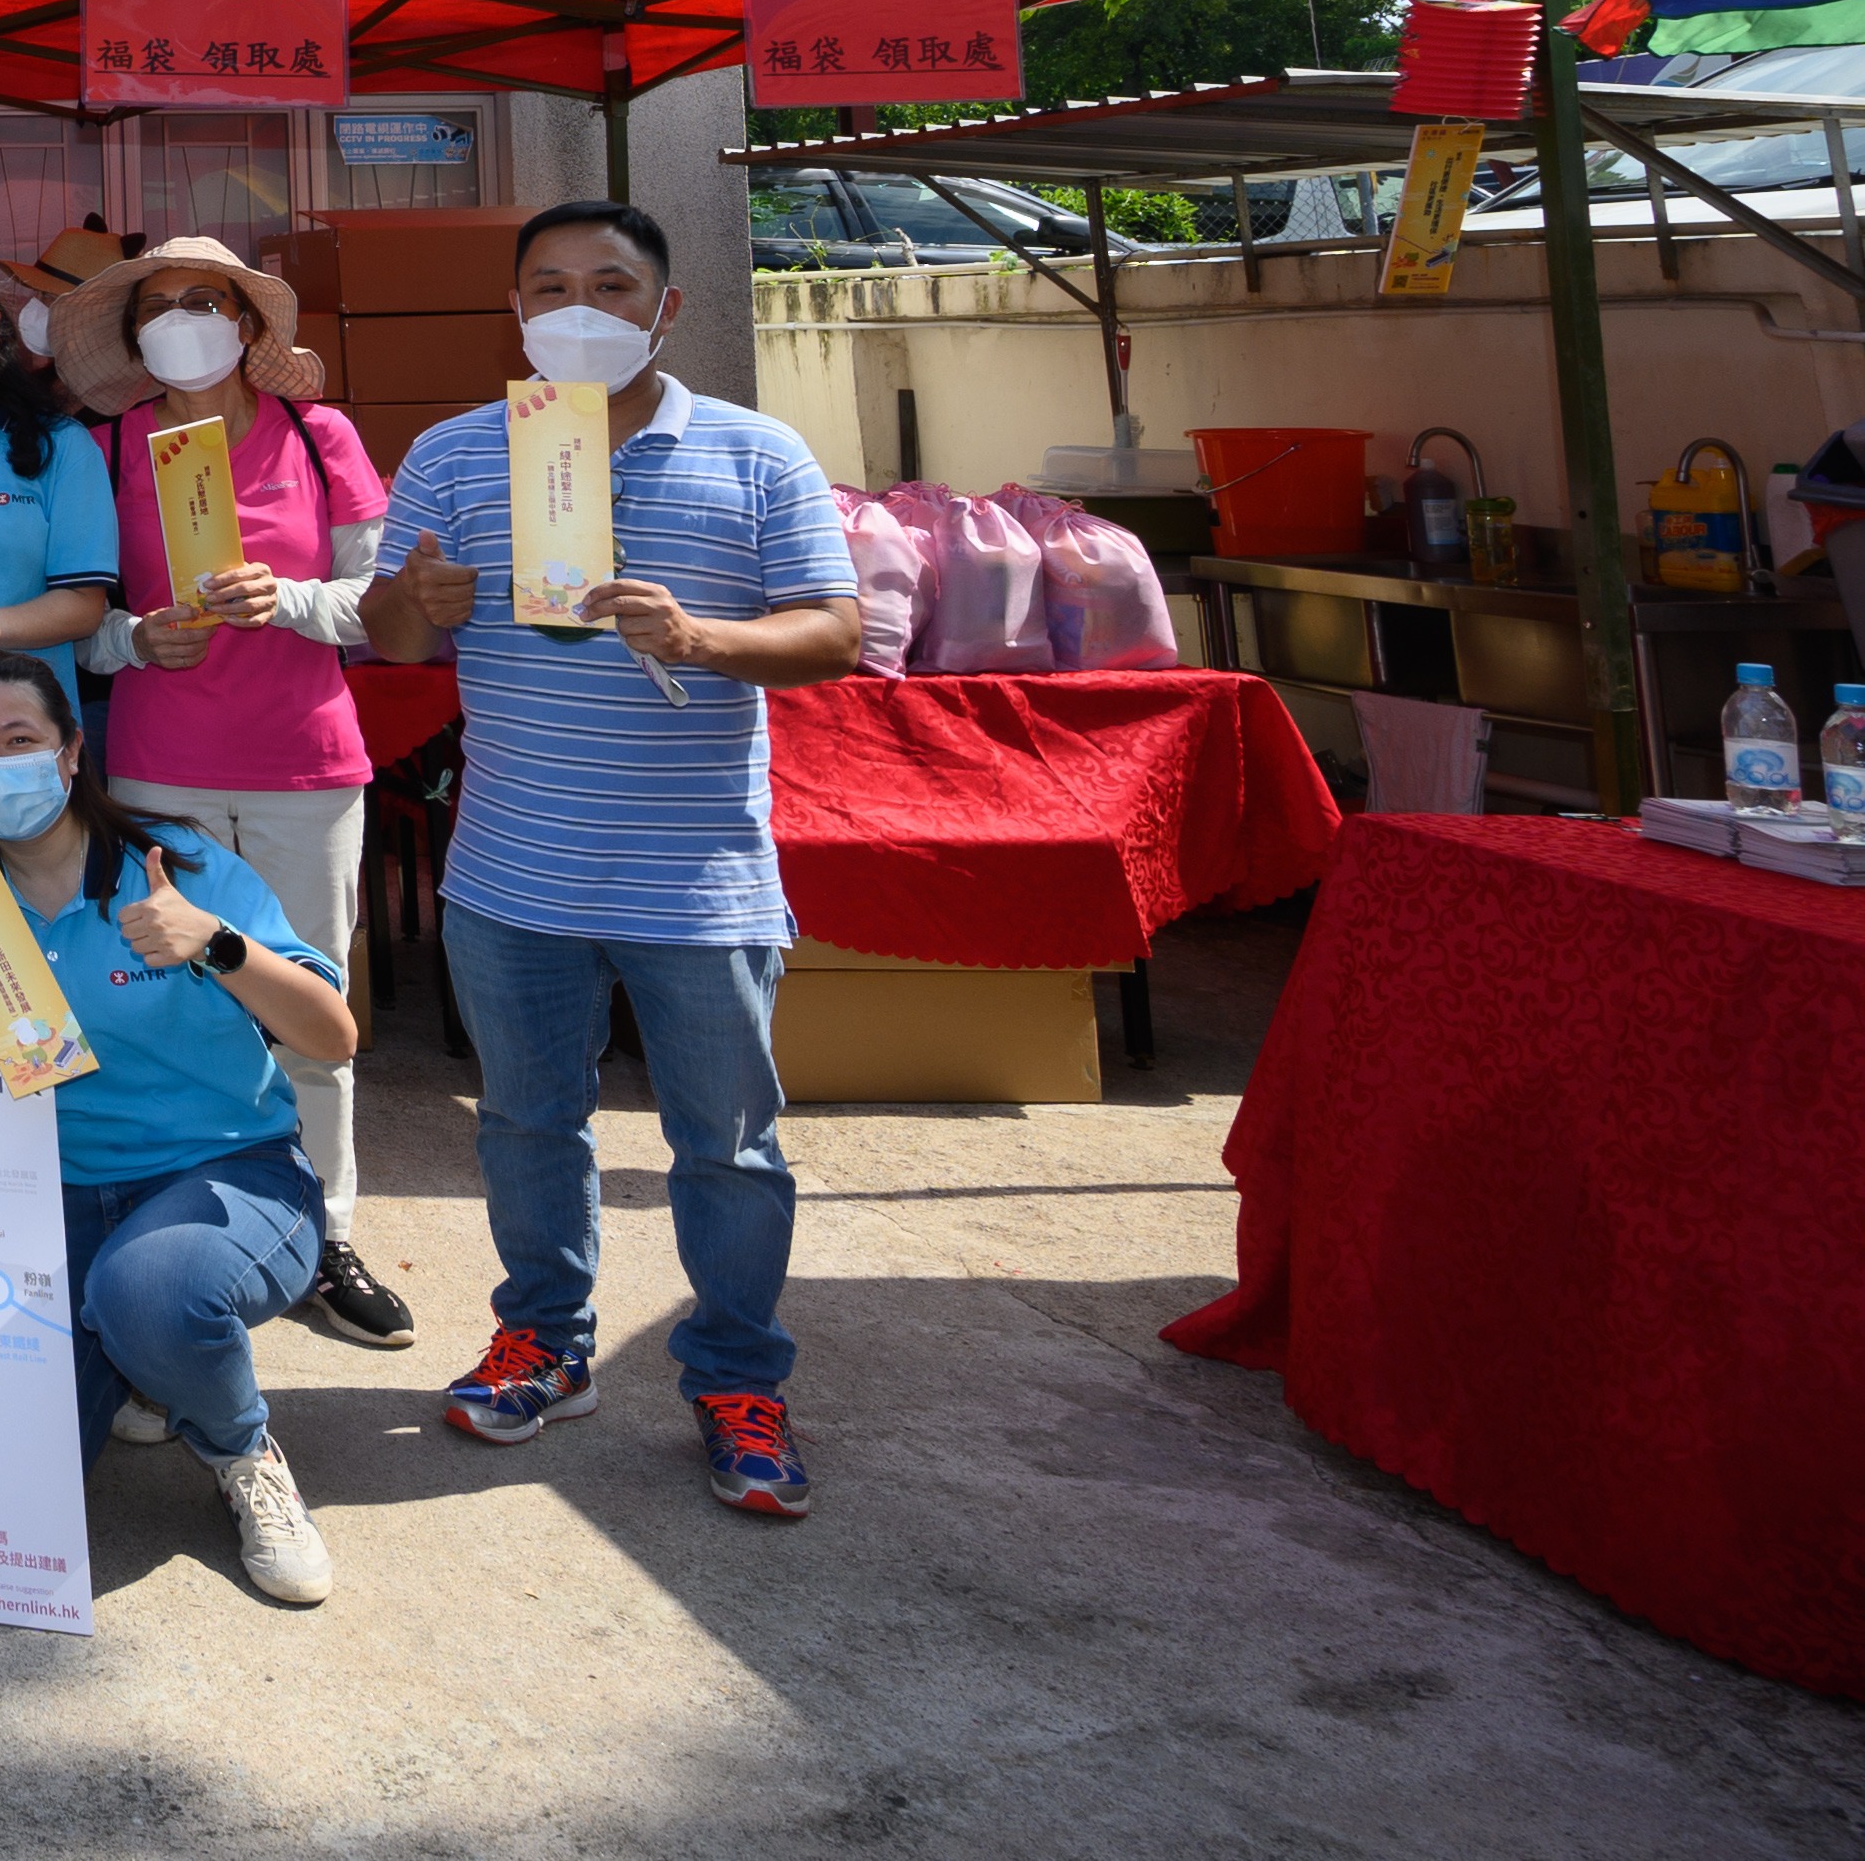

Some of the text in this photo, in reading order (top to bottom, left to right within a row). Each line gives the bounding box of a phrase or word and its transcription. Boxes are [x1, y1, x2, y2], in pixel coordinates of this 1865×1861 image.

[95, 37, 327, 75] 福袋 領取處
[762, 30, 1003, 74] 福袋 領取處
[339, 135, 428, 143] CCTV IN PROGRESS
[559, 443, 573, 512] 一綫中途繫三站
[11, 494, 36, 505] MTR
[129, 968, 168, 982] MTR
[23, 1271, 52, 1288] 粉嶺
[23, 1288, 54, 1301] Fanling
